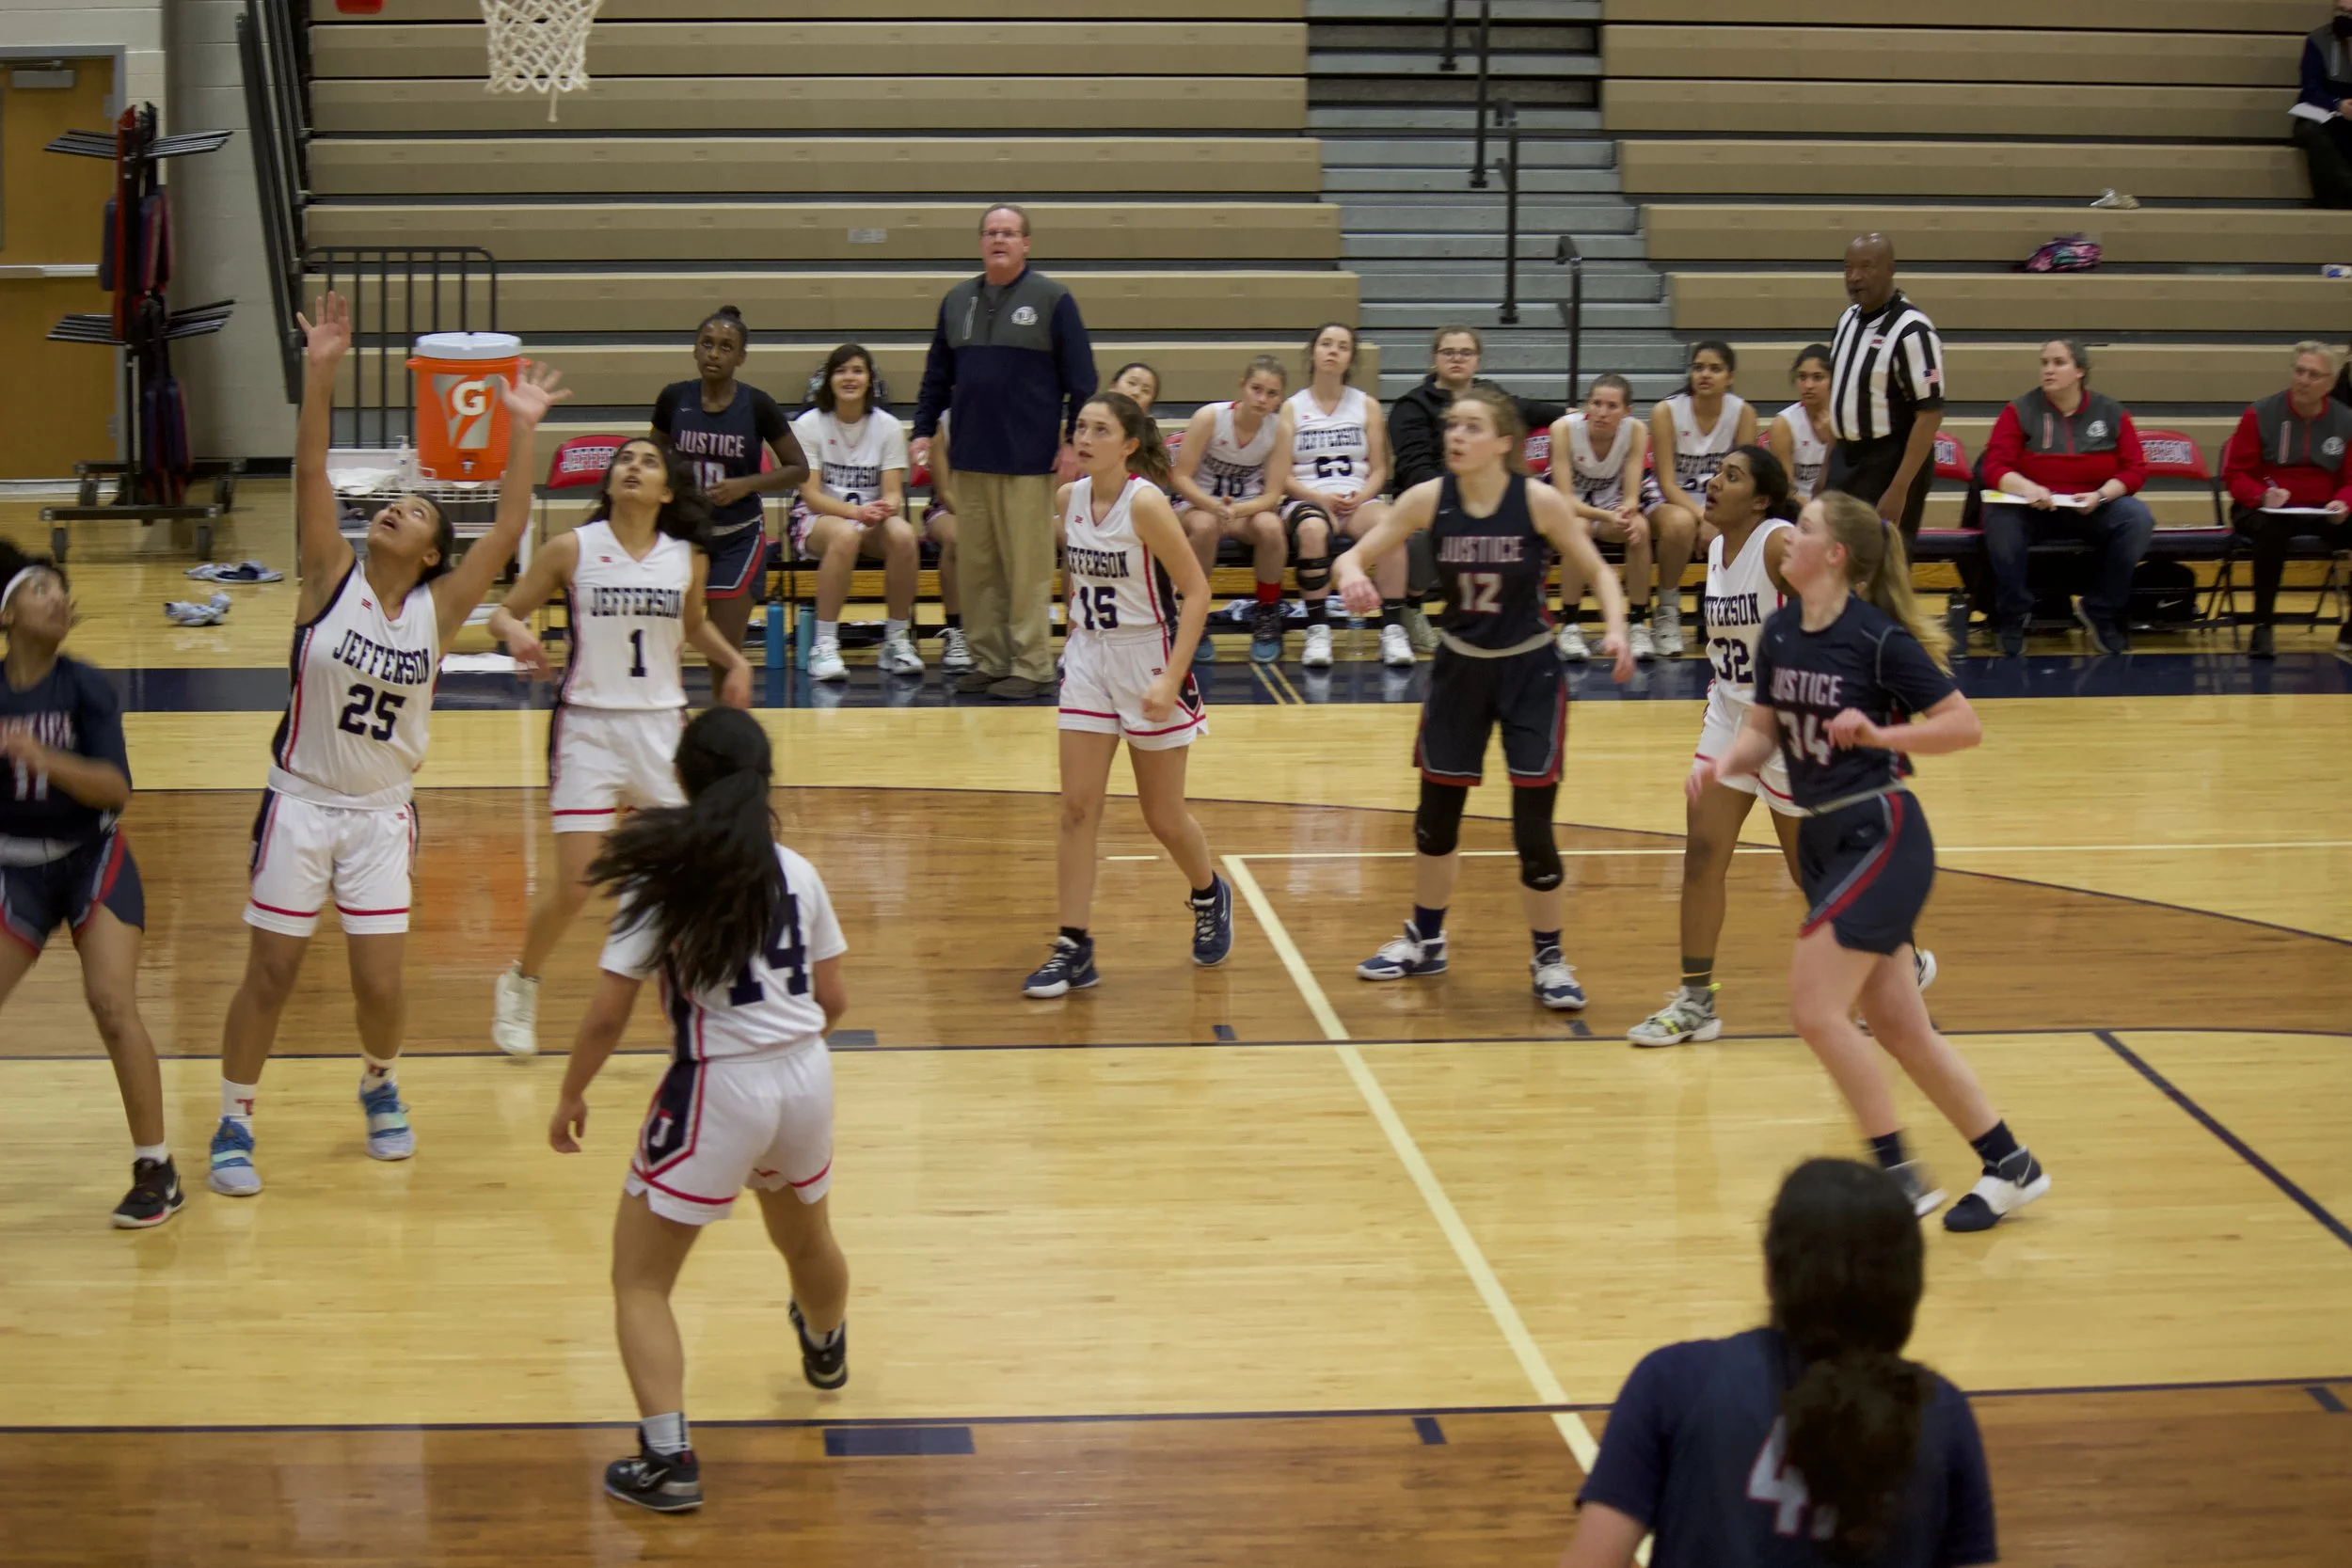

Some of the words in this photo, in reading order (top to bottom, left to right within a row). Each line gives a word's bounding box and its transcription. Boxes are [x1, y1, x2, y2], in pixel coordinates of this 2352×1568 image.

[452, 381, 486, 416] G
[675, 429, 745, 458] JUSTICE
[1438, 535, 1524, 562] JUSTICE
[590, 587, 680, 619] JEFFERSON
[1079, 586, 1119, 630] 15
[1458, 572, 1503, 612] 12
[629, 628, 647, 677] 1
[1712, 637, 1755, 683] 32
[338, 683, 406, 741] 25
